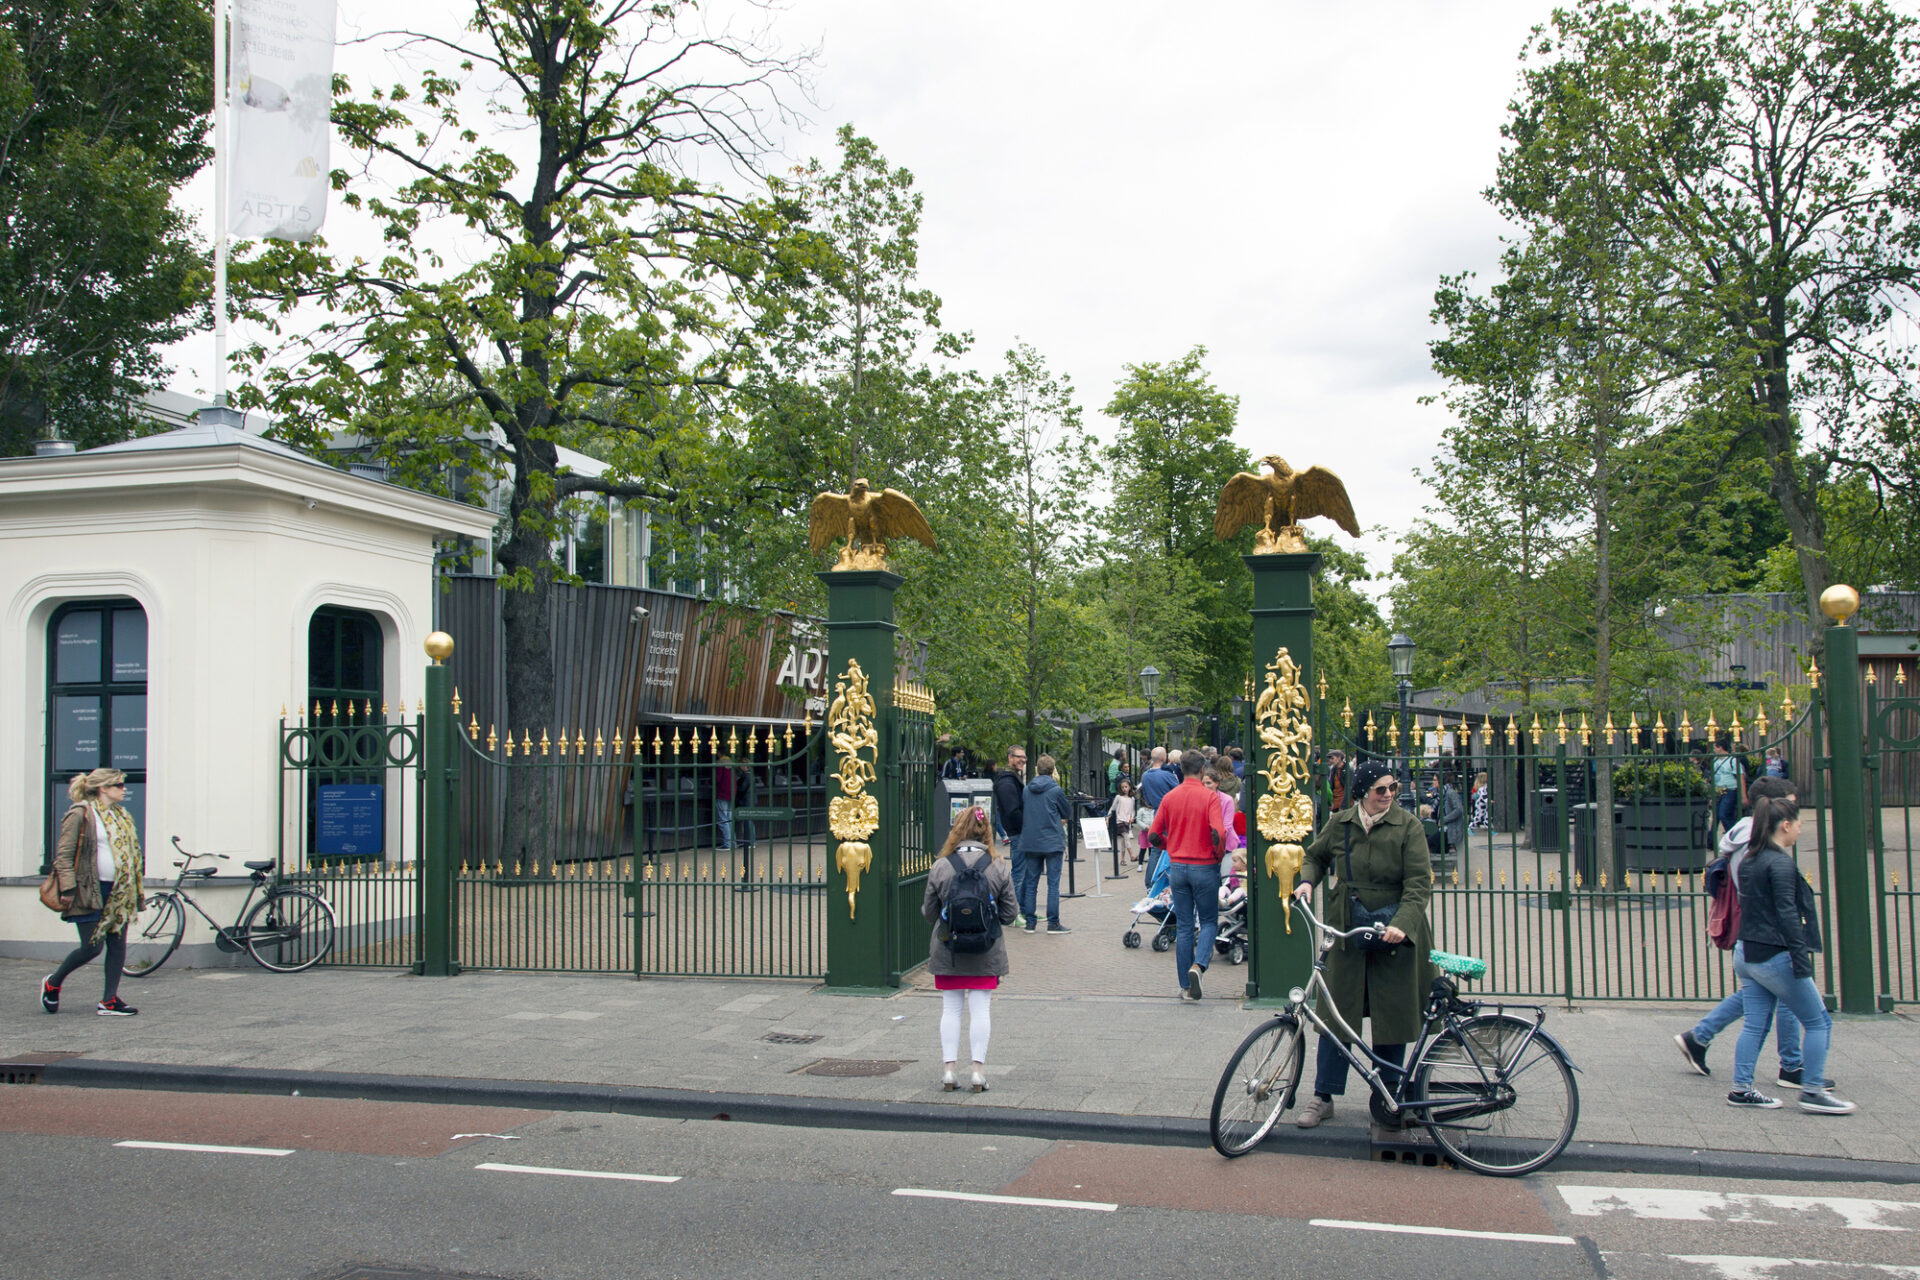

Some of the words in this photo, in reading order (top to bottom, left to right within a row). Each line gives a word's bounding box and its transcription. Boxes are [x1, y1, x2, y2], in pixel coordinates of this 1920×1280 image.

[240, 199, 312, 222] ARTIS
[651, 628, 684, 642] kaartjes
[649, 645, 677, 656] tickets
[646, 665, 679, 675] Artis-park
[645, 677, 673, 687] Micropia
